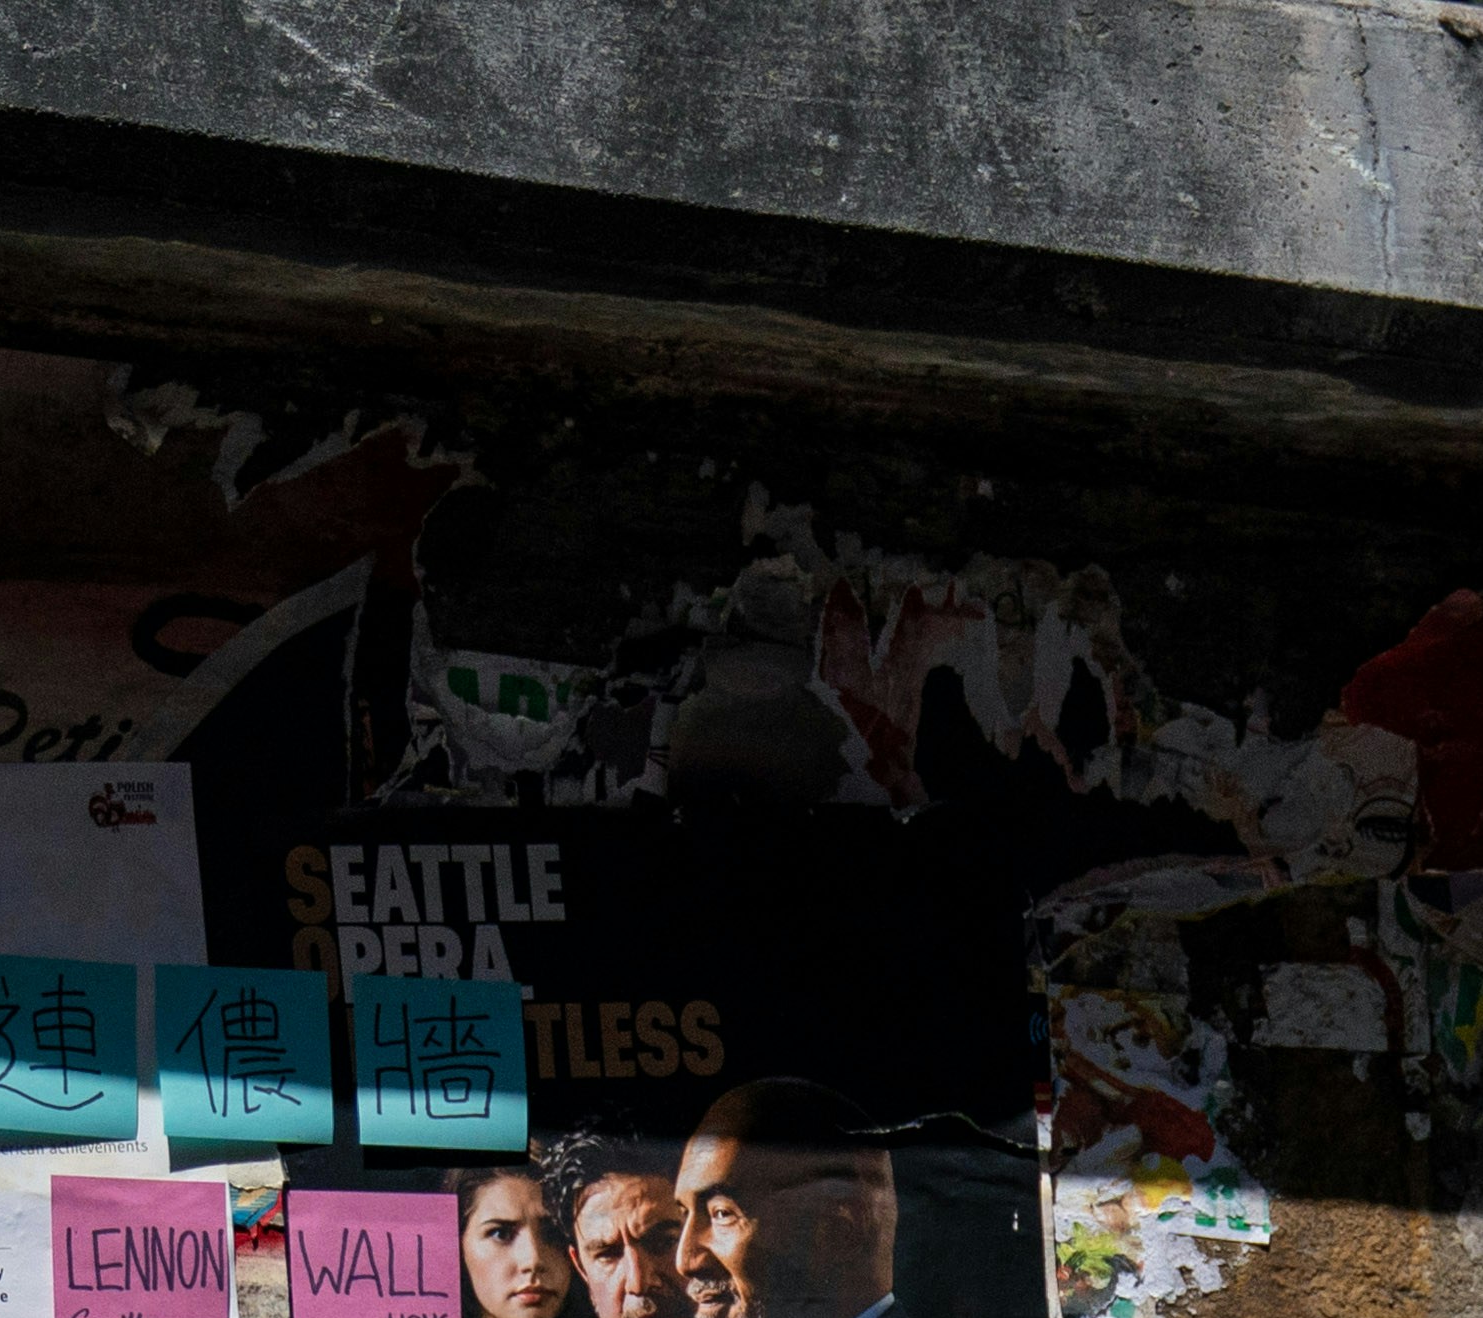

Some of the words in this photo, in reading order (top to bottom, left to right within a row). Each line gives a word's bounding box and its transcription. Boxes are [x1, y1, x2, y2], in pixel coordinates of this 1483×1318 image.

[284, 843, 566, 925] SEATTLE
[174, 988, 301, 1119] 儂
[373, 995, 501, 1119] 牆
[65, 1225, 227, 1292] LENNON
[298, 1228, 448, 1301] WALL
